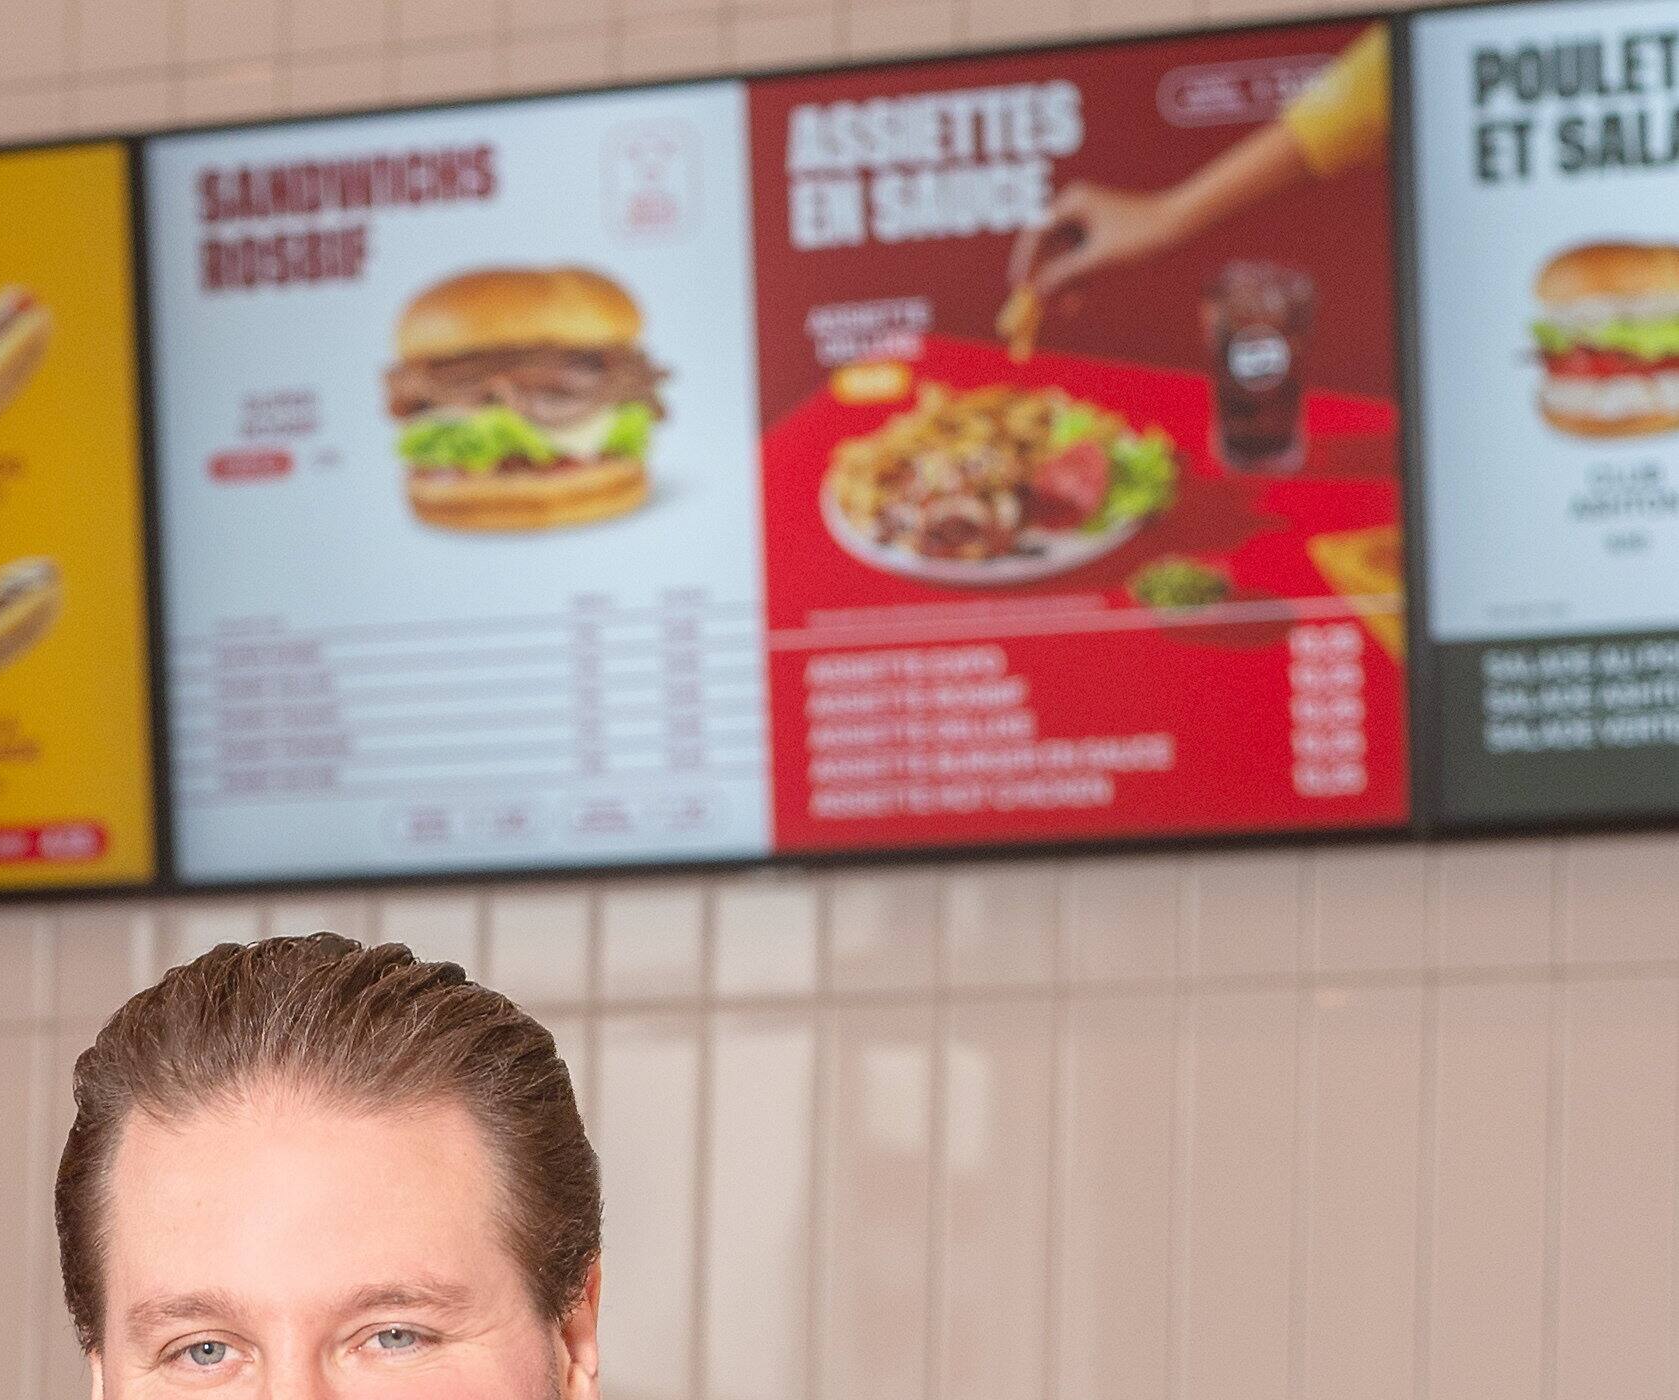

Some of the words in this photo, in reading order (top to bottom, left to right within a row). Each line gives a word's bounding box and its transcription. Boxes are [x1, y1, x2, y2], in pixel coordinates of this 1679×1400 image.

[1471, 29, 1679, 113] POULET
[788, 82, 1082, 175] ASSIETTES
[1473, 116, 1539, 185] ET
[195, 139, 501, 229] SANDWICHS
[872, 157, 1051, 242] SAUCE
[196, 219, 375, 296] ROSBIF
